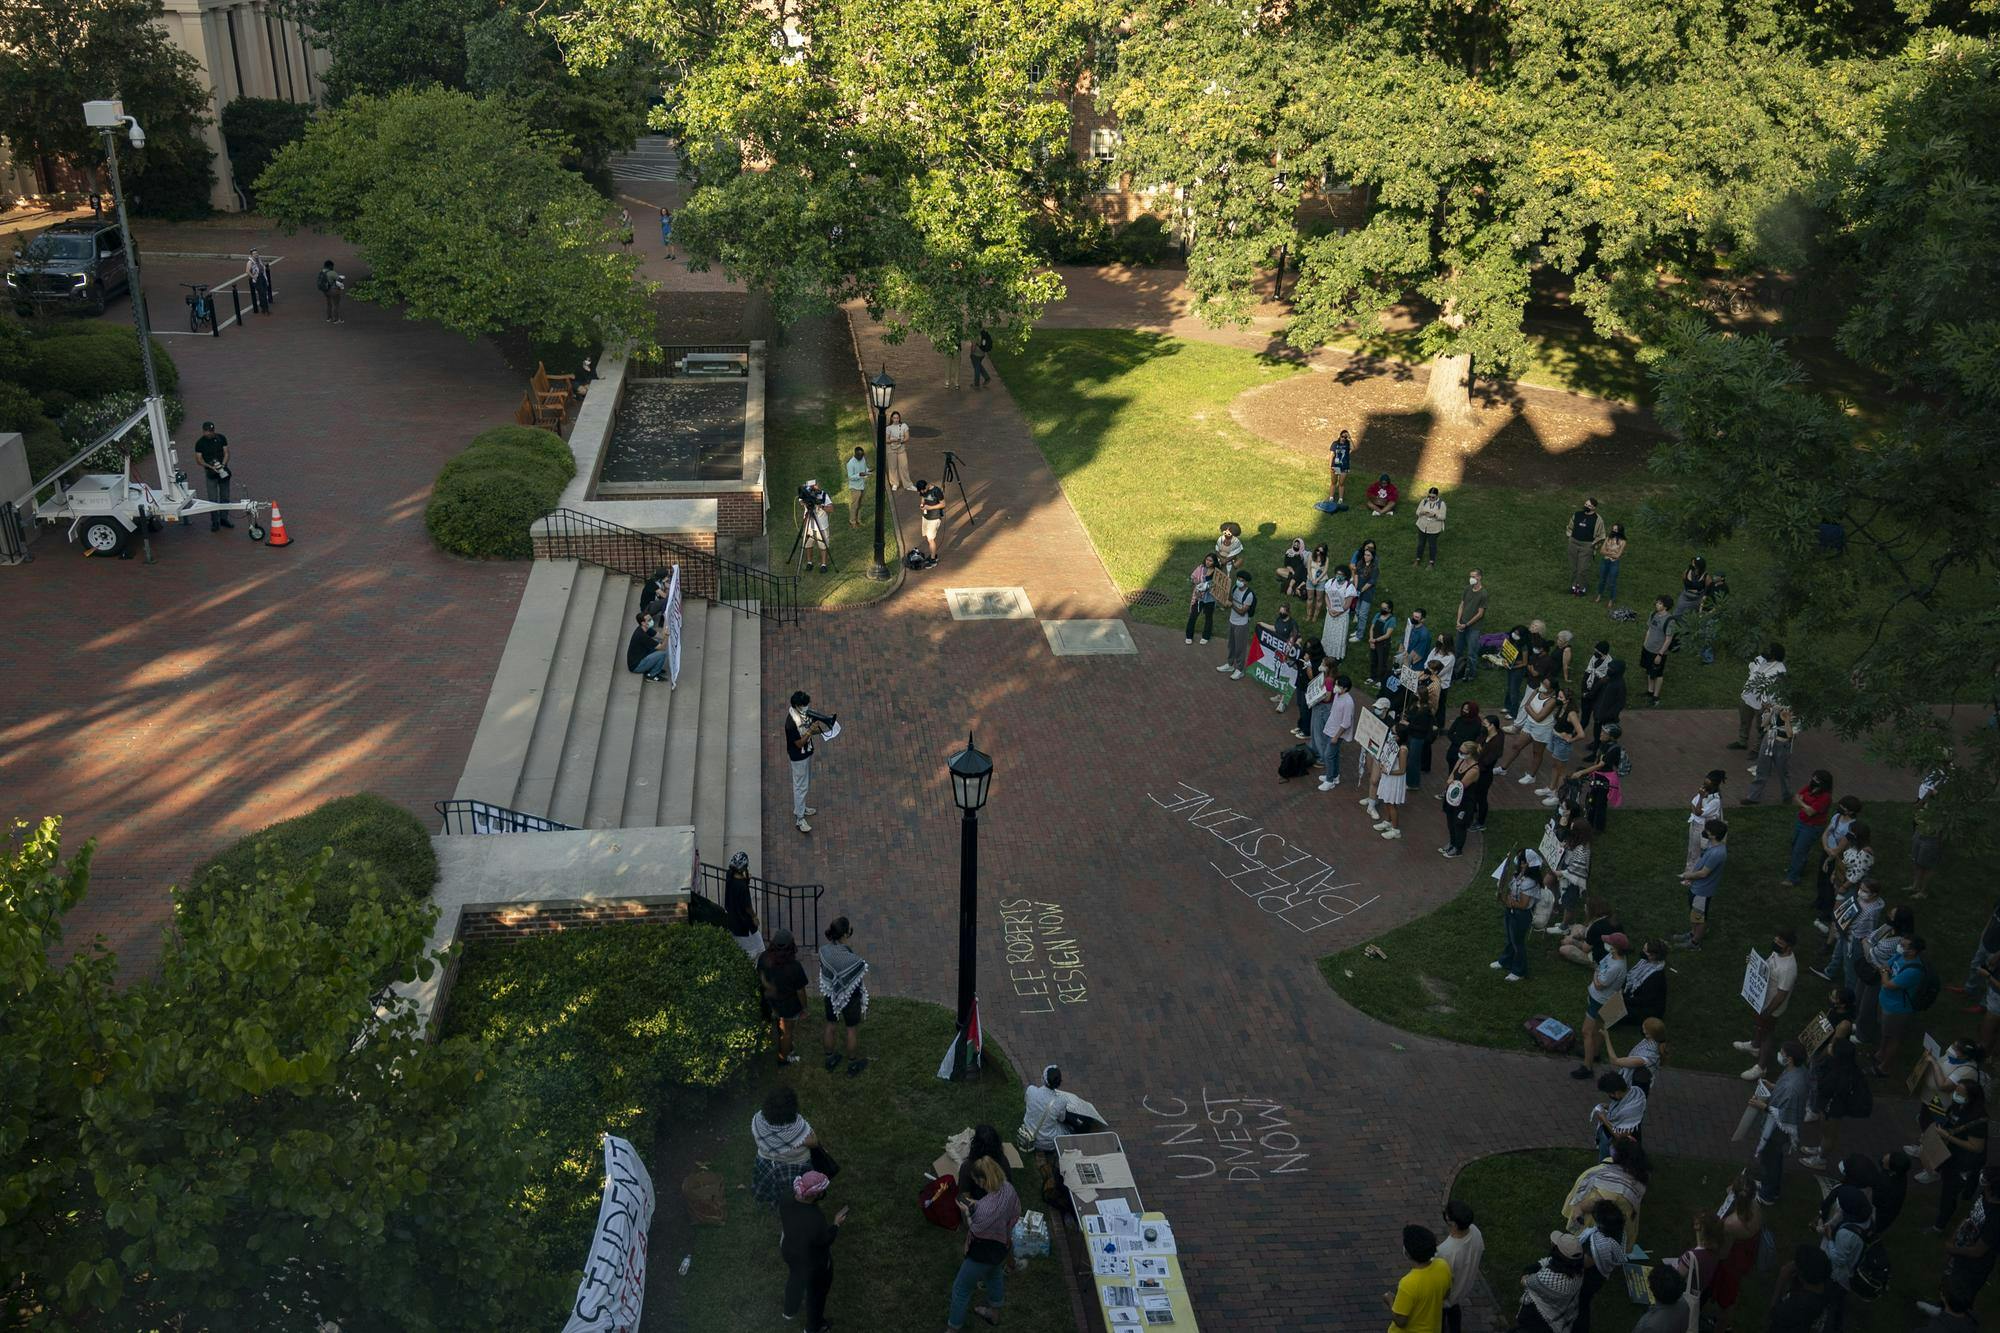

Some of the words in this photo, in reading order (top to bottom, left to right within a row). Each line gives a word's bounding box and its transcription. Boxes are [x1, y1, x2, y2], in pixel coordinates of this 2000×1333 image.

[1256, 667, 1288, 690] PALEST
[1147, 781, 1381, 916] PALESTINE
[1034, 901, 1066, 936] NOW
[1210, 861, 1344, 933] FREE
[1000, 899, 1035, 964] ROBERTS
[1010, 969, 1055, 1014] LEE
[1043, 939, 1088, 1004] RESIGN
[1143, 1095, 1216, 1178] UNC
[1203, 1087, 1260, 1181] DIVEST
[576, 1139, 640, 1333] STUDENT
